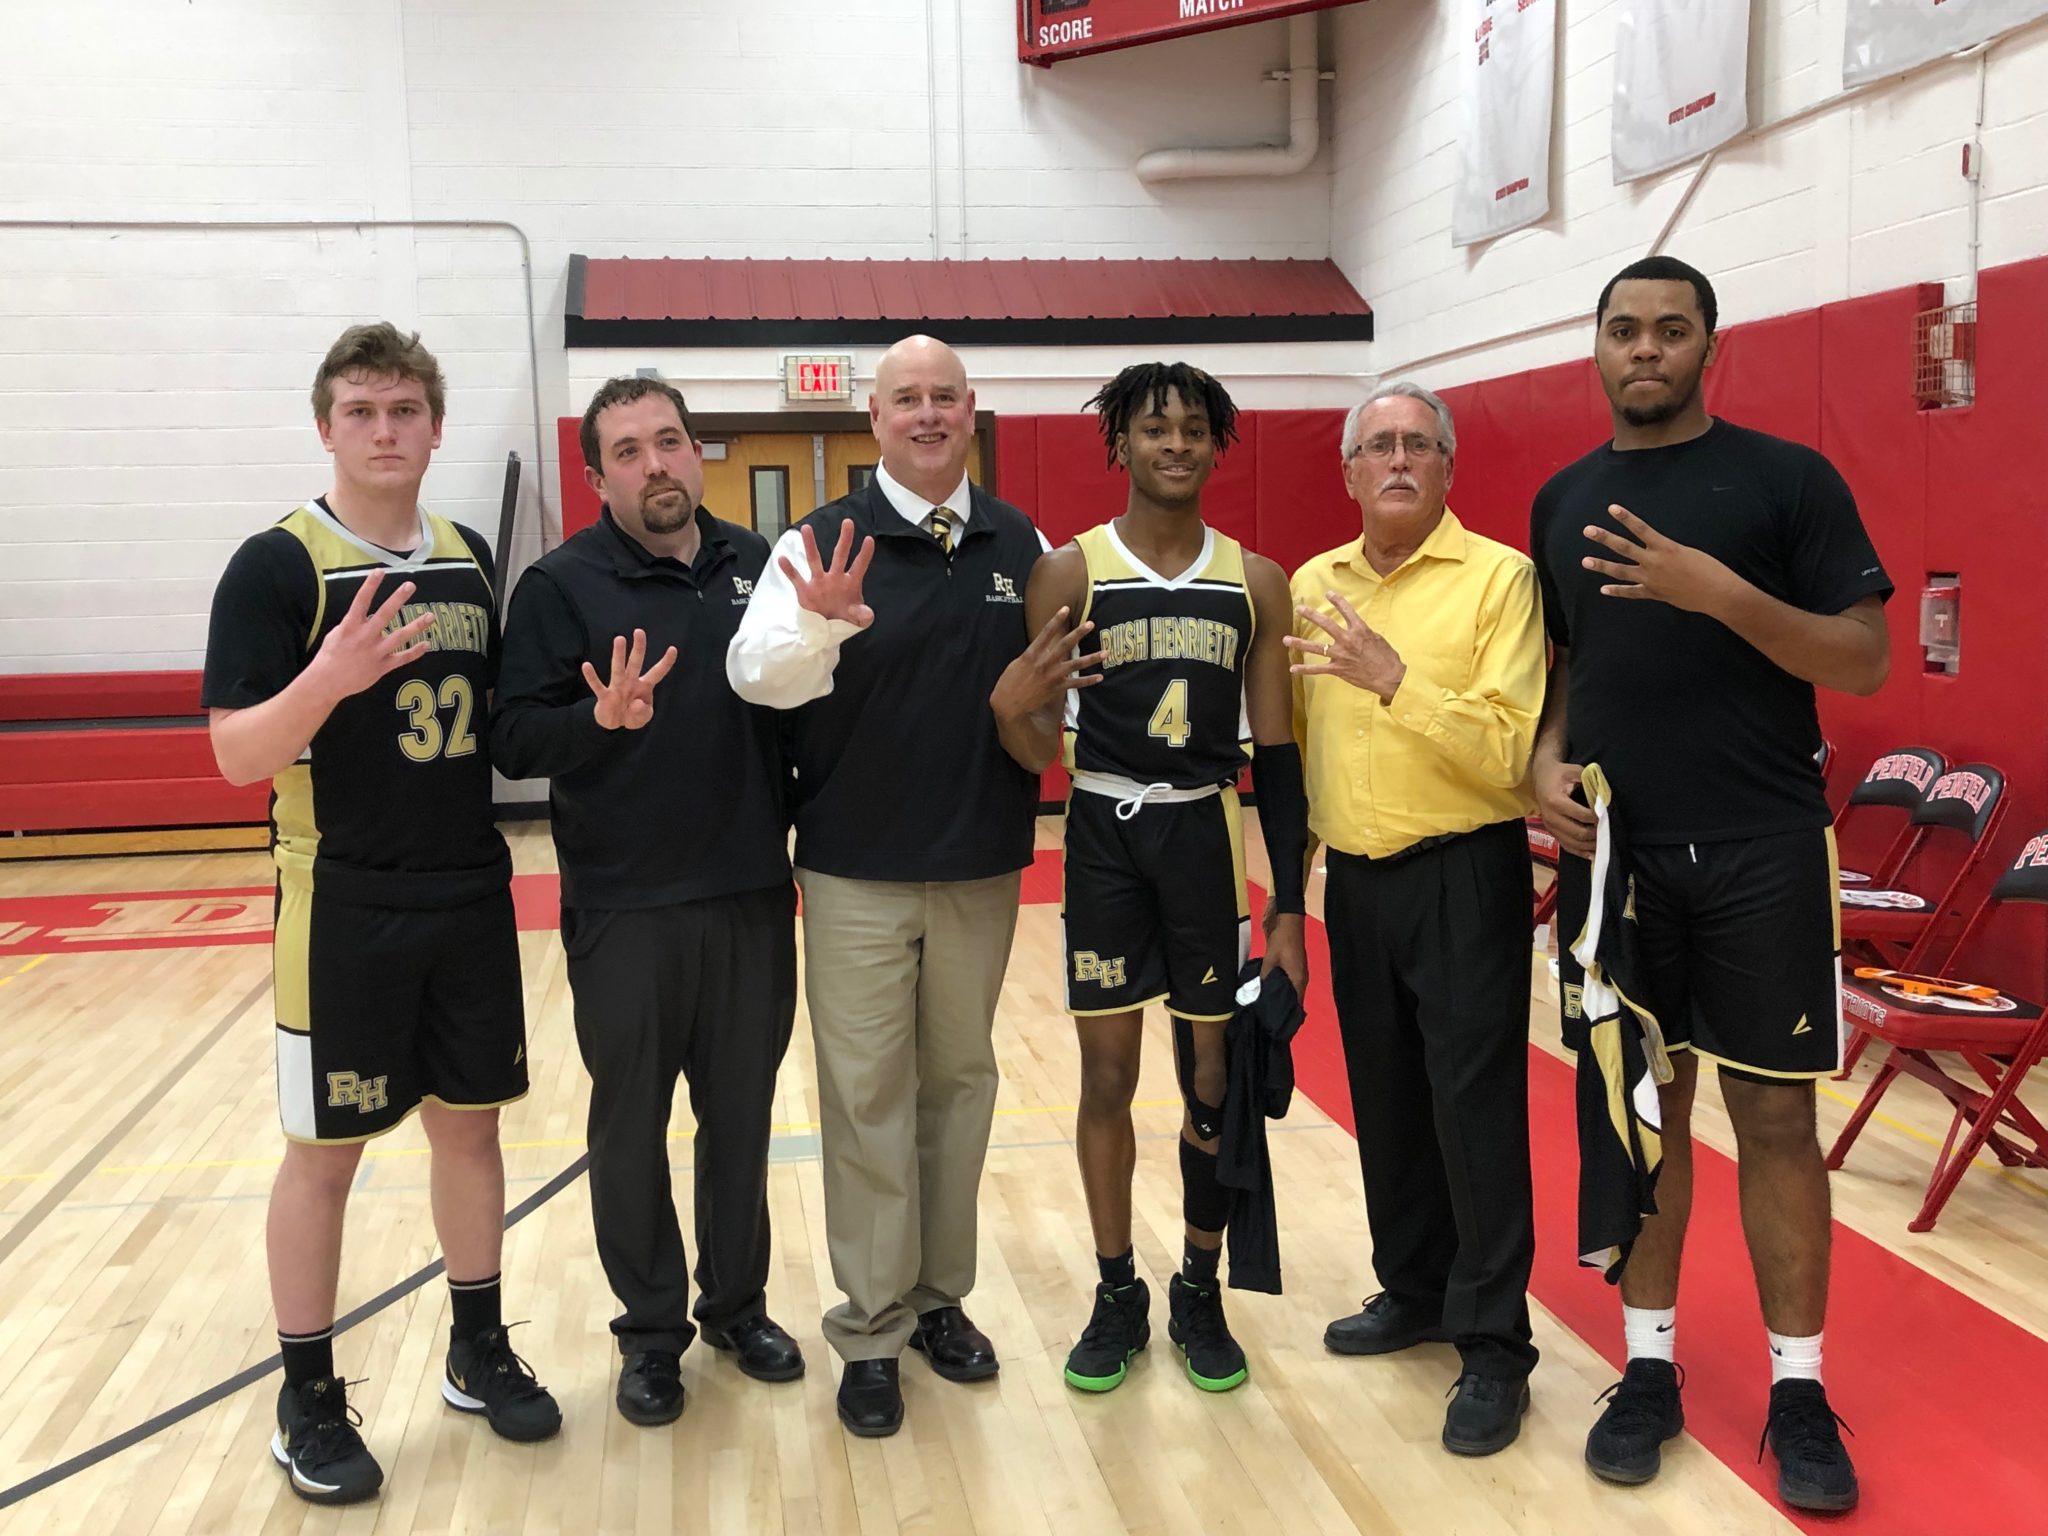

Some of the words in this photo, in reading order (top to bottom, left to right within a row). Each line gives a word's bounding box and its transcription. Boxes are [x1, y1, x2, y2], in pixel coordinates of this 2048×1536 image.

[1039, 17, 1093, 47] SCORE
[799, 363, 839, 392] EXIT
[1099, 618, 1149, 670] RUSH
[1150, 616, 1238, 672] HENRIETTA
[395, 673, 477, 763] 32
[1147, 679, 1191, 748] 4
[2013, 834, 2048, 870] PE
[1073, 950, 1127, 989] RH
[1841, 988, 1887, 1028] TRIOTS
[326, 1070, 388, 1114] RH
